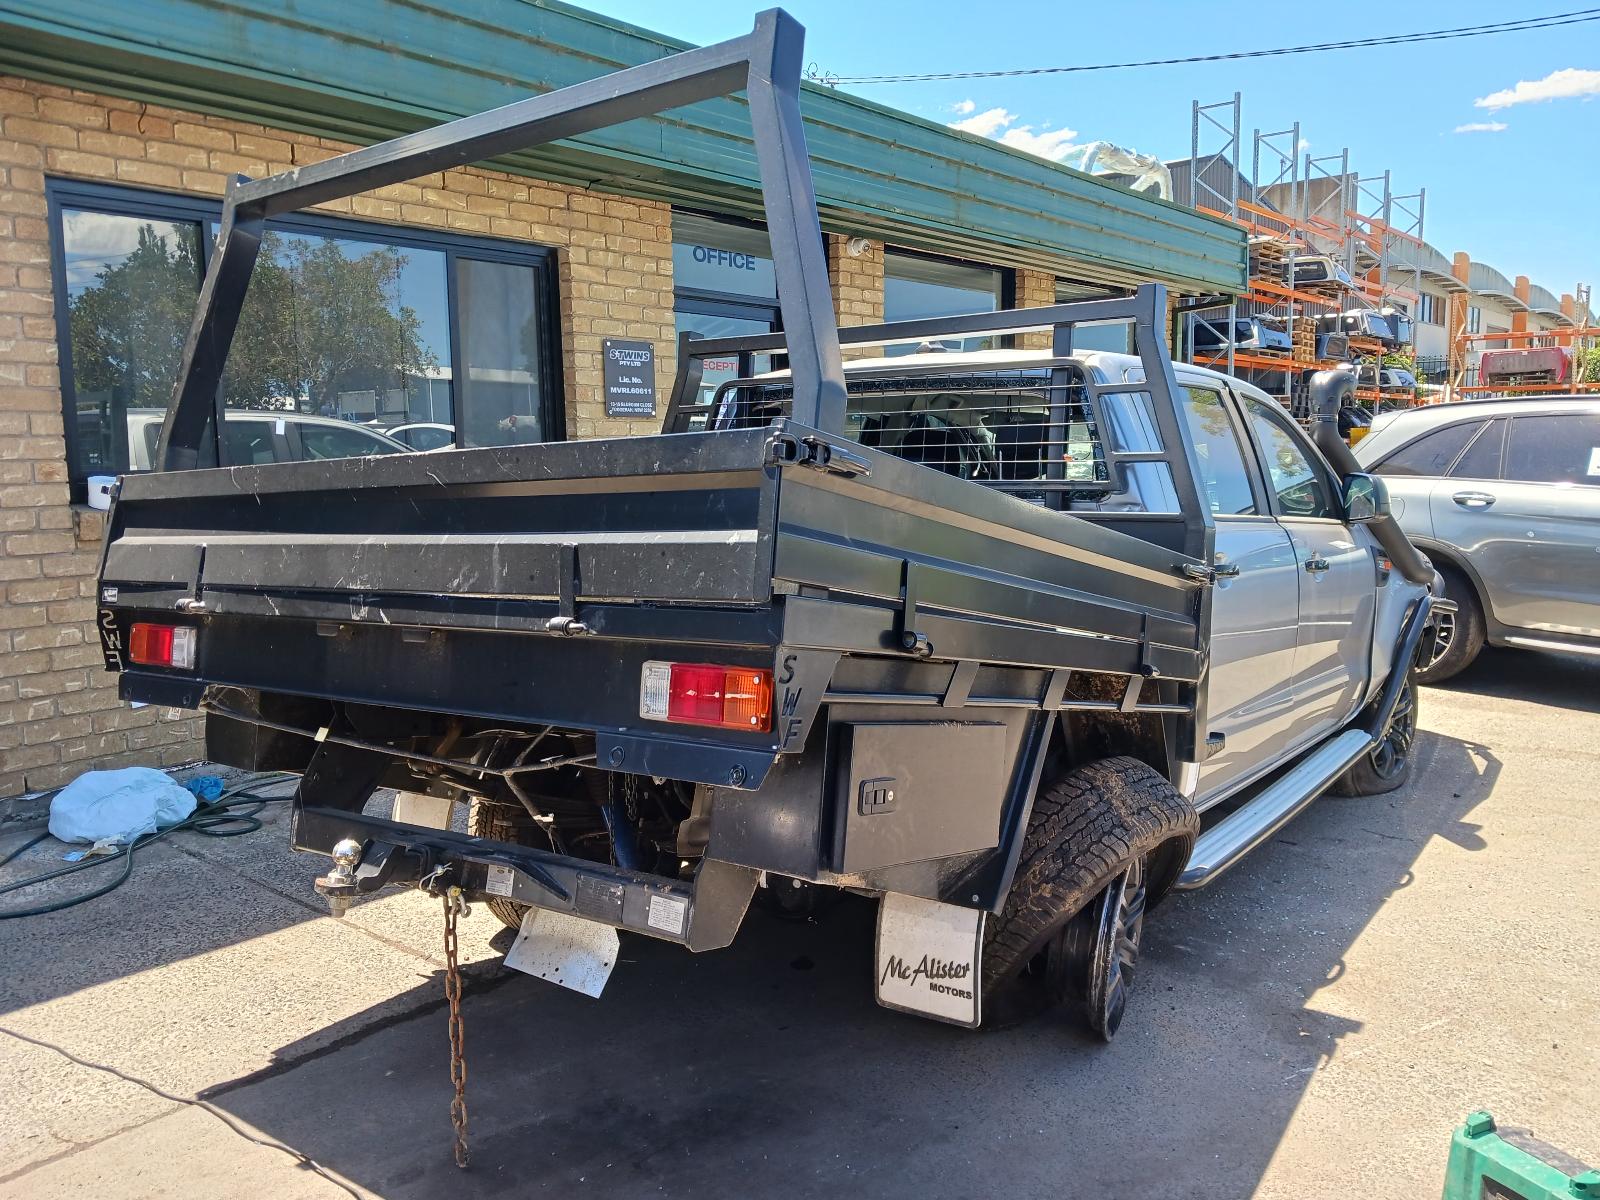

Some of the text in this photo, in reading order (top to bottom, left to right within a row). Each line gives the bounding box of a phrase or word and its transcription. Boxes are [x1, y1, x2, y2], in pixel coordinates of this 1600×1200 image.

[693, 246, 756, 270] OFFICE
[779, 655, 802, 748] SWF
[929, 982, 973, 1000] MOTORS
